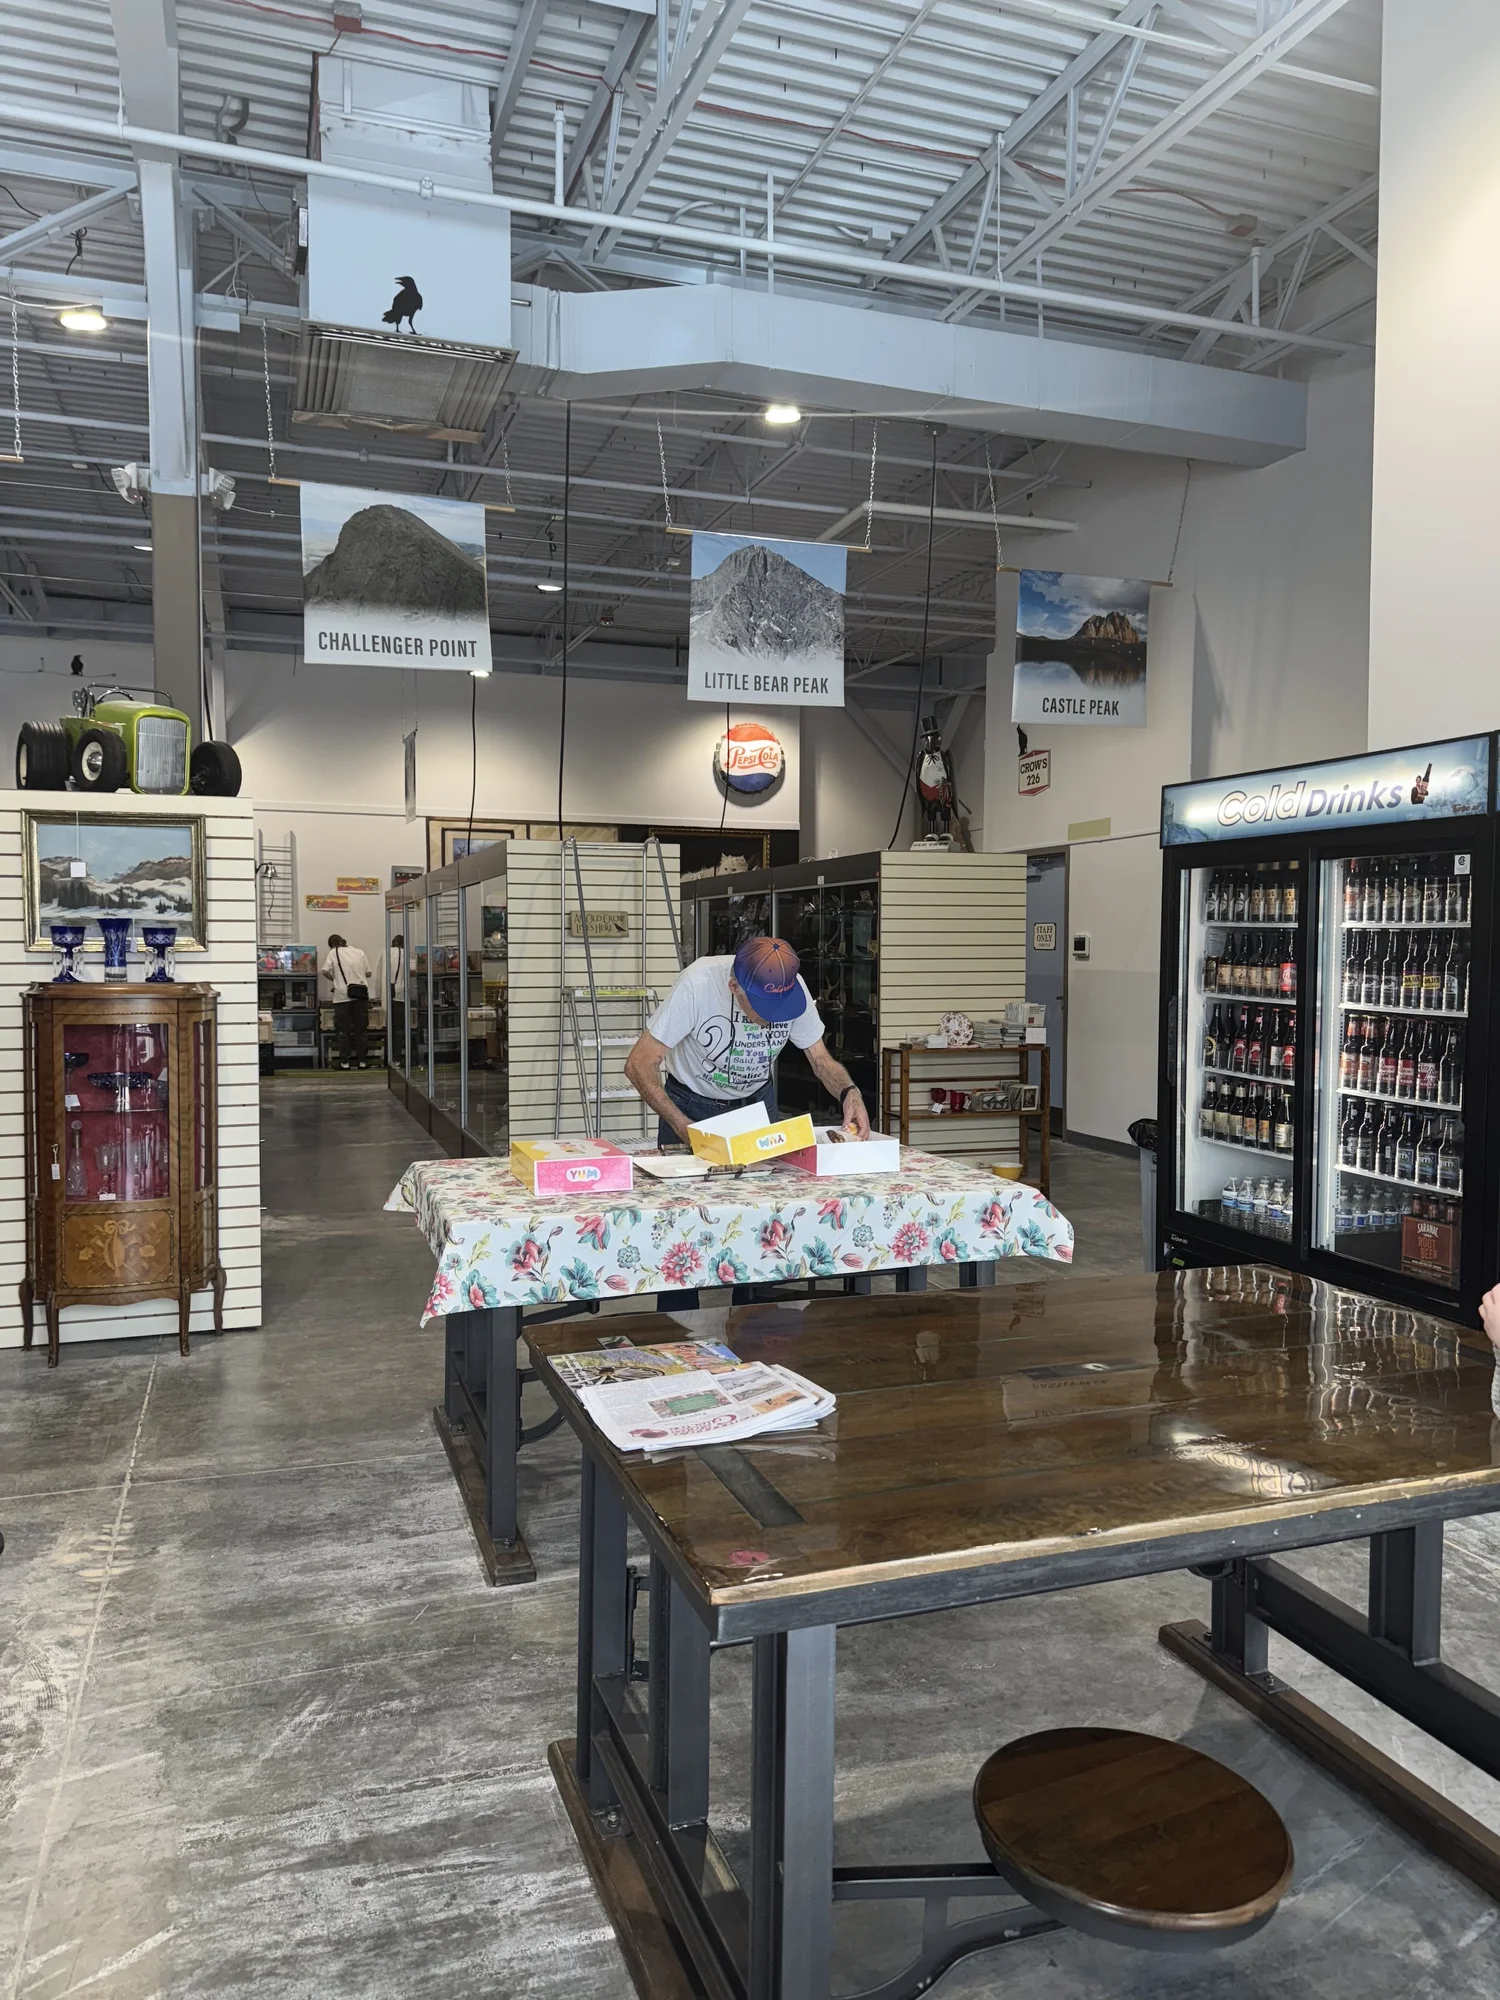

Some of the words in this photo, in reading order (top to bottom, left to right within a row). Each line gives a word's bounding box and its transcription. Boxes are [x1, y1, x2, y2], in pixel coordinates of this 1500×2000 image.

[318, 631, 424, 655] CHALLENGER
[429, 639, 477, 658] POINT
[704, 671, 749, 691] LITTLE
[754, 675, 788, 692] BEAR
[793, 677, 829, 694] PEAK
[1042, 697, 1086, 714] CASTLE
[1089, 699, 1119, 716] PEAK
[1026, 773, 1041, 786] 226
[1217, 780, 1306, 827] Cold
[1305, 780, 1404, 817] Drinks
[586, 914, 602, 925] OLD
[603, 914, 626, 925] CROW
[576, 923, 594, 933] LIES
[595, 923, 614, 934] HERE
[1036, 925, 1053, 934] STAFF
[1036, 934, 1053, 942] ONLY
[759, 1134, 785, 1148] YUM
[570, 1168, 598, 1180] YUM
[1417, 1236, 1436, 1249] ROOT
[1420, 1247, 1438, 1260] BEER
